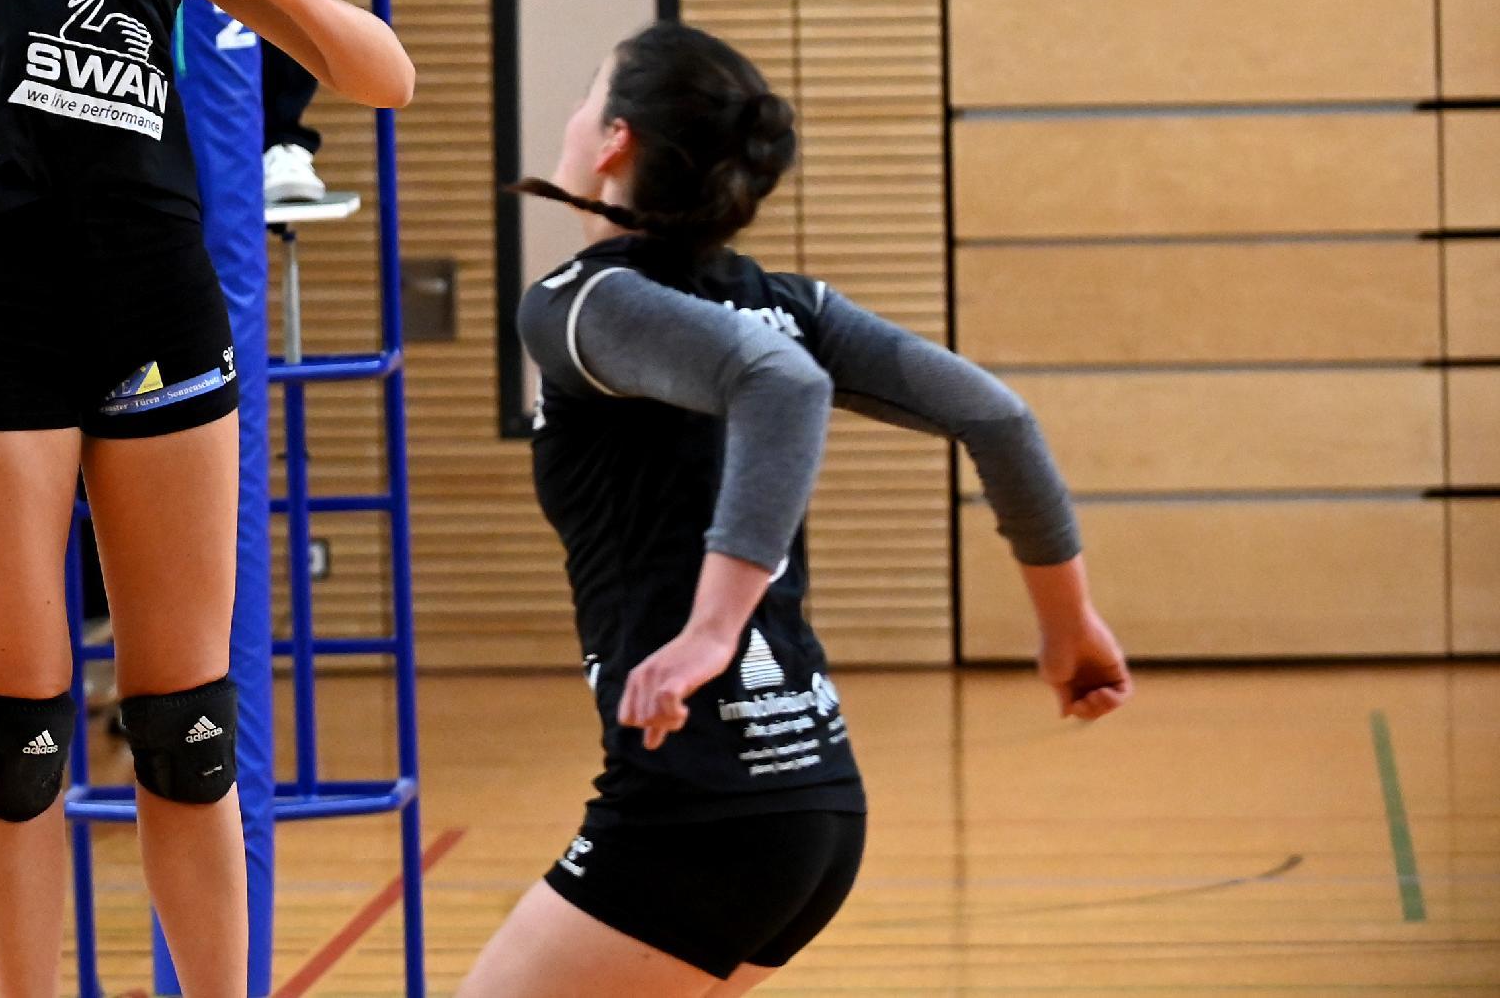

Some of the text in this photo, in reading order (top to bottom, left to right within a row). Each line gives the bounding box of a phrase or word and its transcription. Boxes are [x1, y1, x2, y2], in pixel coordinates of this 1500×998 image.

[26, 42, 168, 114] SWAN
[27, 87, 161, 134] we live performance
[100, 402, 129, 412] enster
[135, 395, 160, 408] Türen
[184, 726, 223, 744] adidas
[22, 744, 58, 755] adidas
